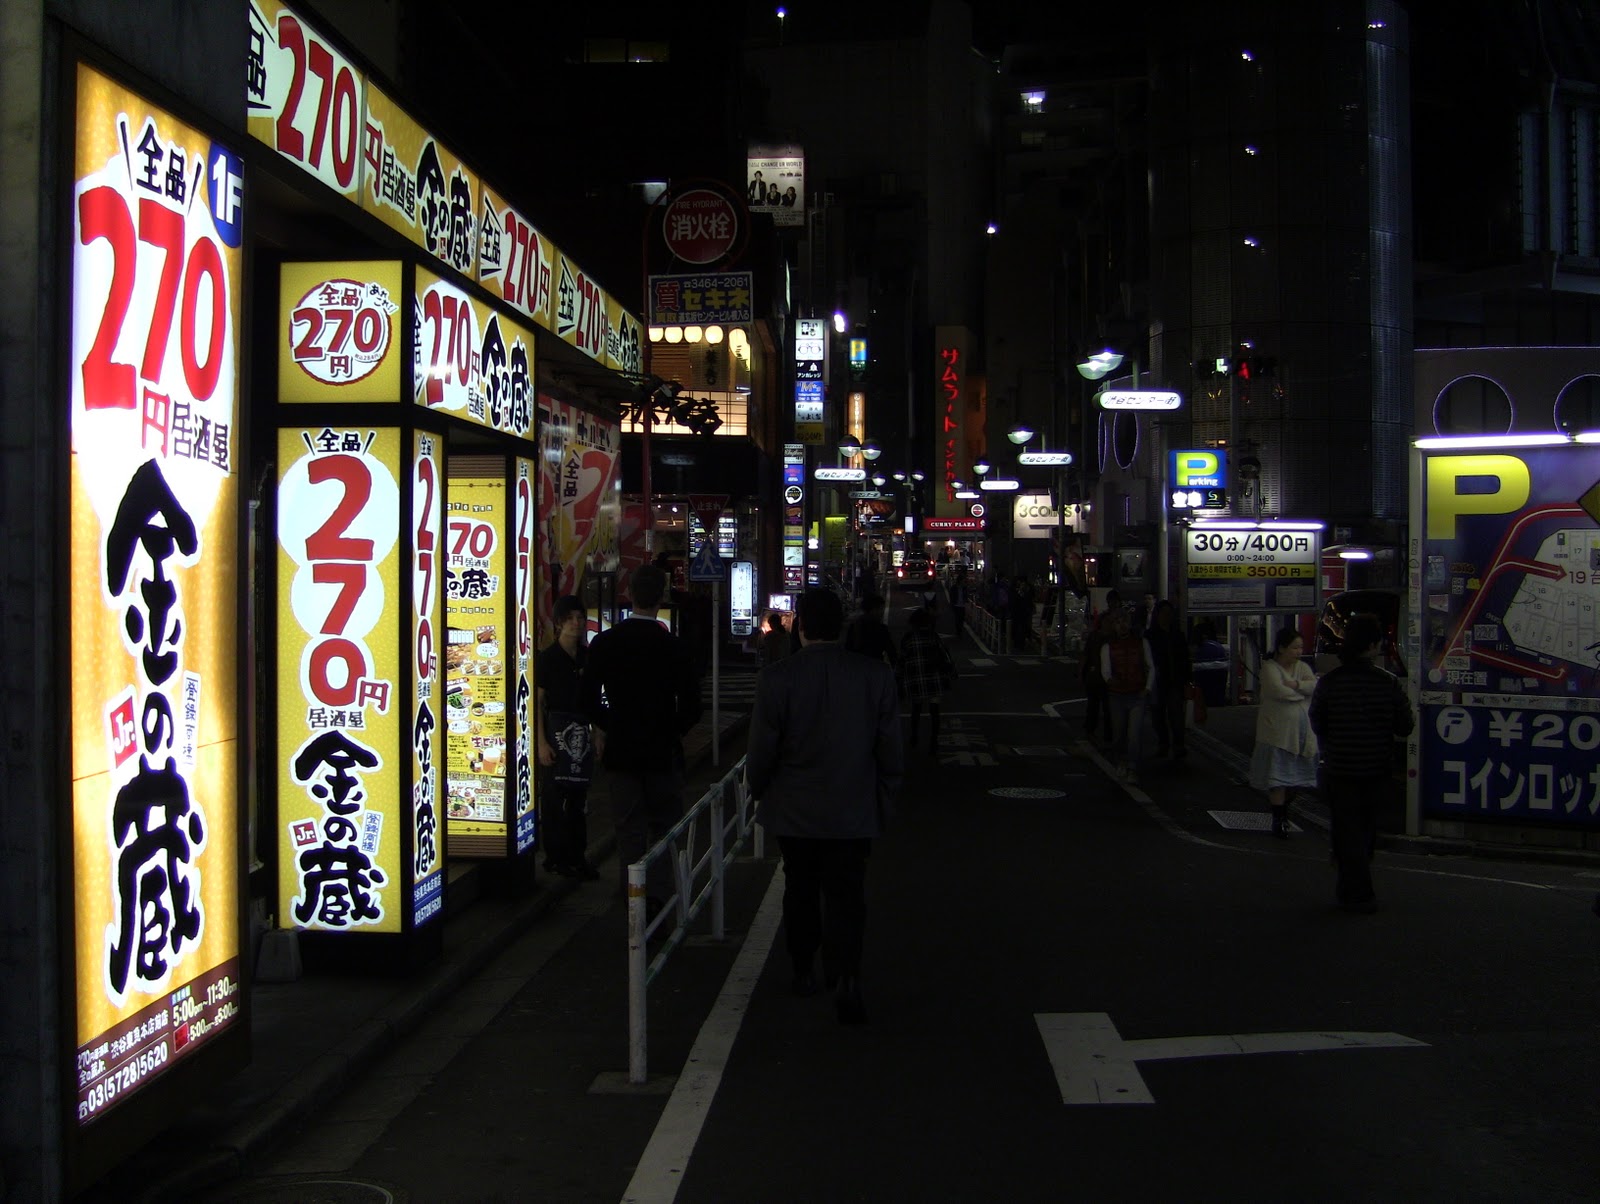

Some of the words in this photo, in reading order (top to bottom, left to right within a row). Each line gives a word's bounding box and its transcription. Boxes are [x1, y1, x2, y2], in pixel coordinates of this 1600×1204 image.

[136, 124, 187, 205] 全品
[212, 153, 243, 225] 1F
[676, 201, 692, 210] FIRE
[693, 200, 725, 209] HYDRANT
[481, 210, 500, 266] 全品
[671, 213, 731, 241] 消火栓
[319, 283, 359, 307] 全品
[558, 268, 575, 322] 全品
[655, 281, 680, 312] 質
[682, 287, 750, 311] セキネ
[293, 307, 382, 360] 270
[330, 355, 350, 375] 円
[941, 348, 960, 433] サムラート
[318, 430, 361, 453] 全品
[564, 458, 580, 497] 全品
[1427, 454, 1531, 540] P
[697, 501, 722, 512] 止まれ
[107, 458, 203, 995] 金の蔵
[113, 711, 136, 754] Jr.
[308, 707, 365, 729] 居酒屋
[295, 730, 381, 926] 金の蔵
[297, 826, 316, 842] Jr.
